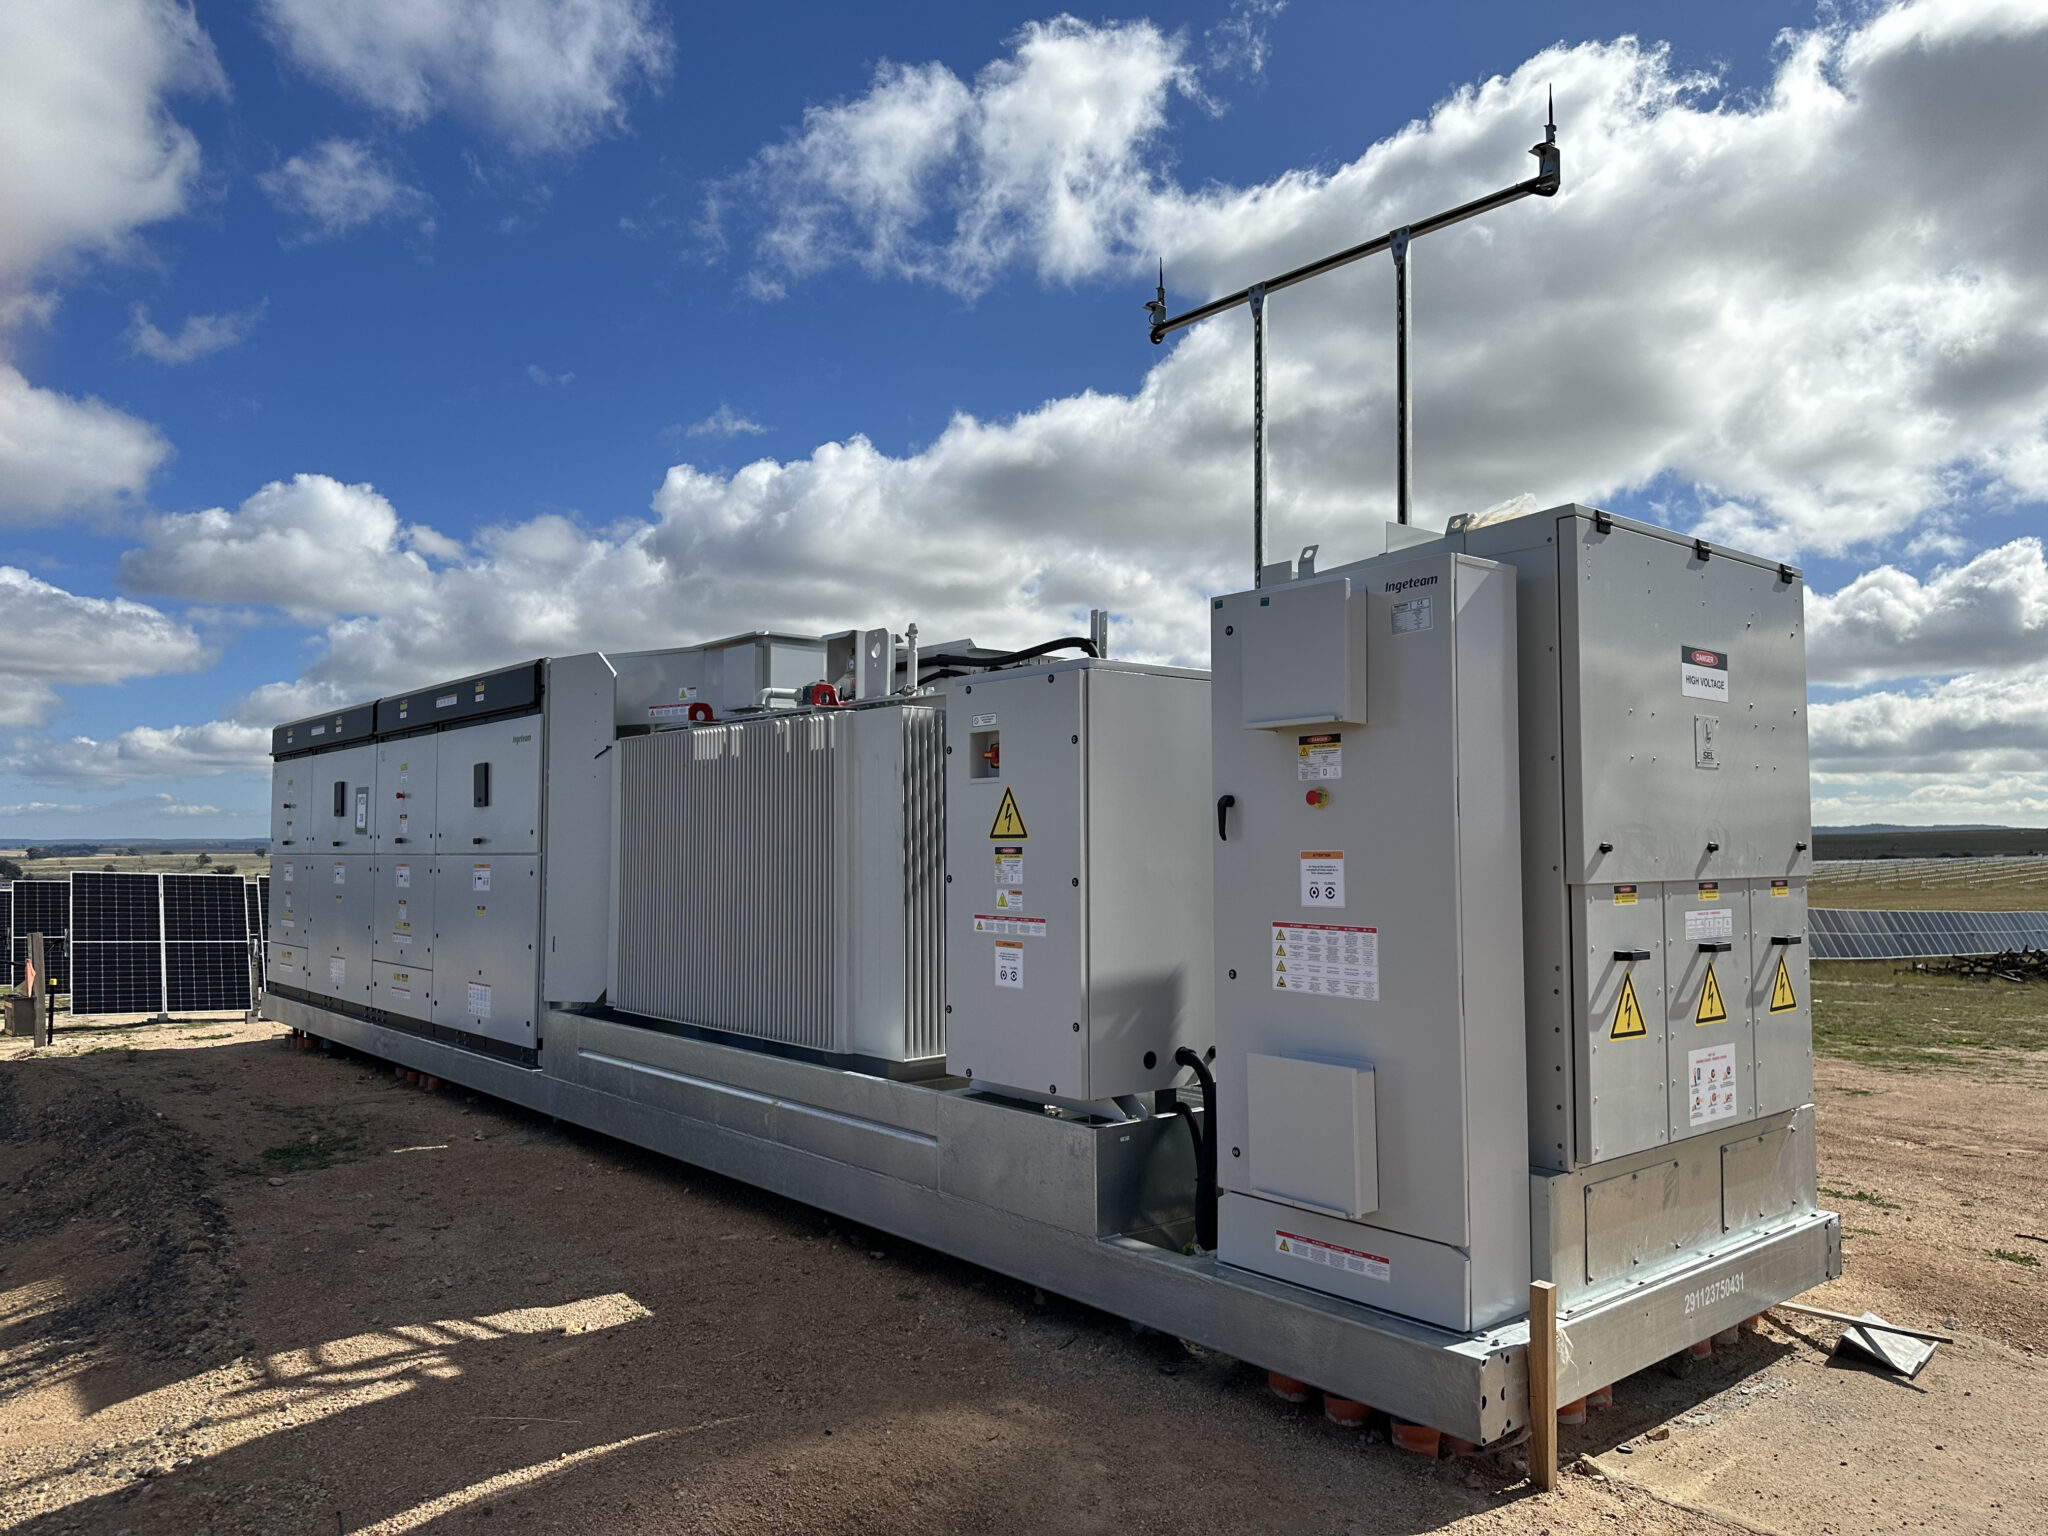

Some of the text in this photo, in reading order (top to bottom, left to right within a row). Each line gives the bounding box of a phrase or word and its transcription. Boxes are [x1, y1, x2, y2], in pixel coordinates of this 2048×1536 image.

[1385, 575, 1438, 593] Ingeteam
[1696, 653, 1714, 664] DANGER
[1686, 675, 1725, 690] HIGH VOLTAGE
[1684, 1271, 1744, 1314] 291123750431
